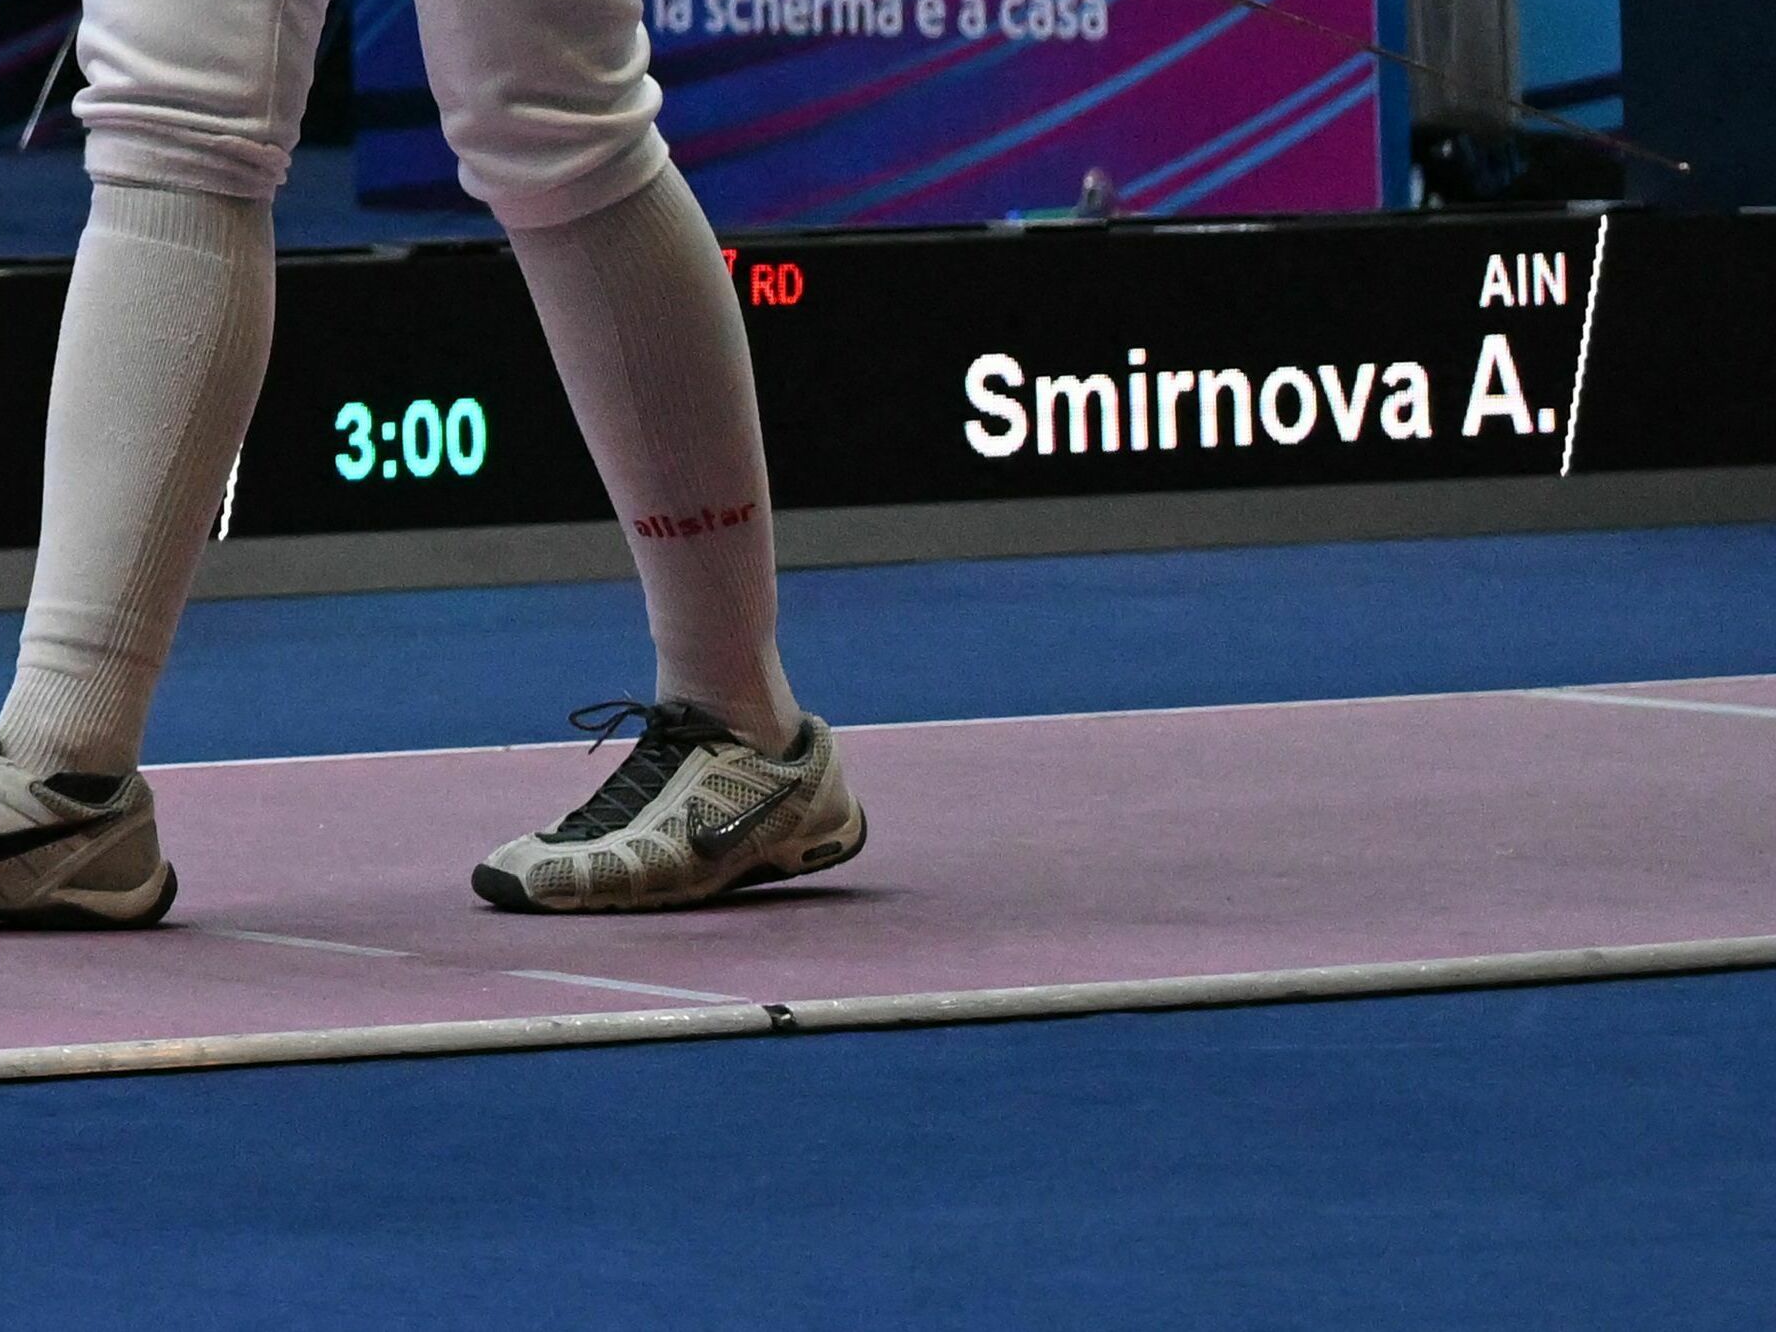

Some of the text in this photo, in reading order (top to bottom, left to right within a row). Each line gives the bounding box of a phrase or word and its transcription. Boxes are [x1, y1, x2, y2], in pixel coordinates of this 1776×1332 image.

[1479, 252, 1567, 308] AIN
[964, 333, 1556, 458] Smirnova A.
[334, 397, 487, 480] 3:00
